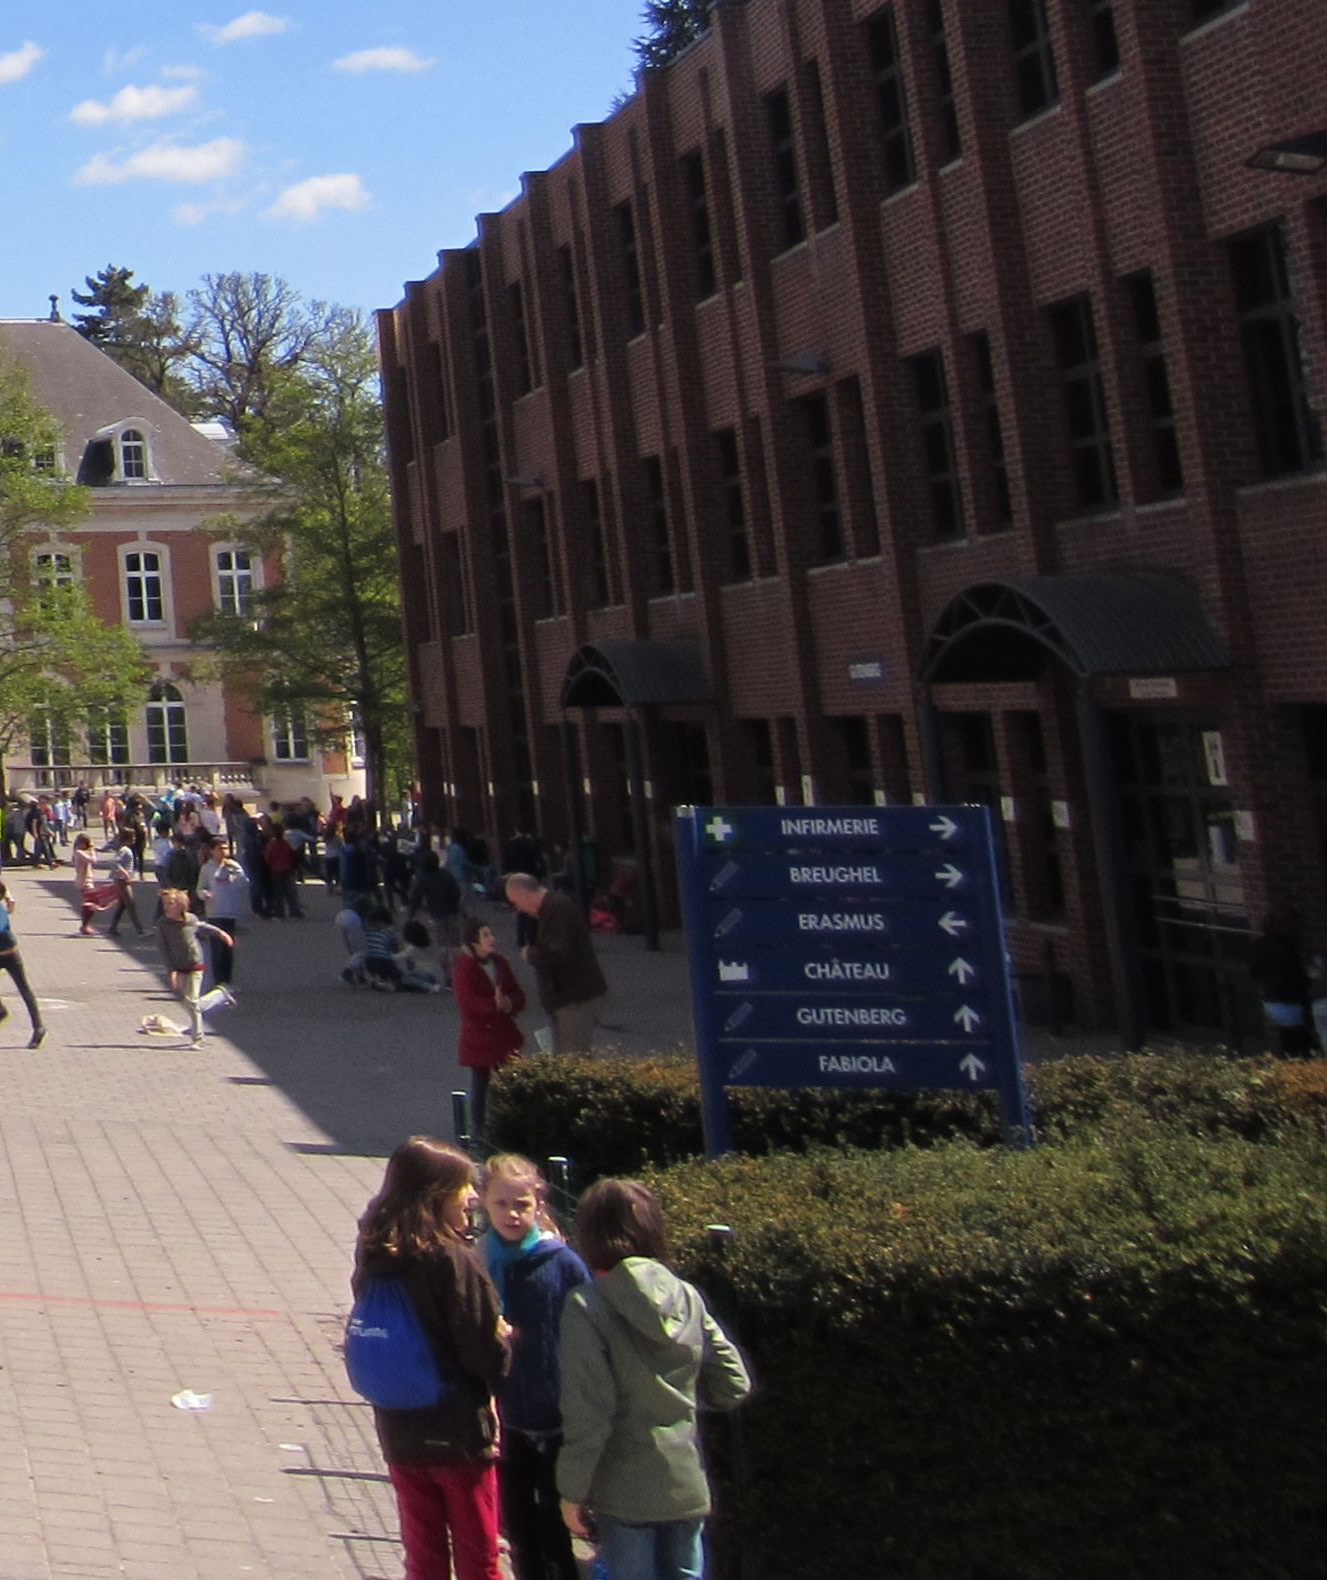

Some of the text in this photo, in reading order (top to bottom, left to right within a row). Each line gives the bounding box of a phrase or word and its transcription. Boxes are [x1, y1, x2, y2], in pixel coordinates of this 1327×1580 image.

[781, 818, 879, 836] INFIRMERIE
[789, 866, 882, 883] BREUGHEL
[798, 913, 885, 931] ERASMUS
[804, 958, 890, 980] CHÂTEAU
[796, 1007, 907, 1026] GUTENBERG
[819, 1055, 896, 1073] FABIOLA
